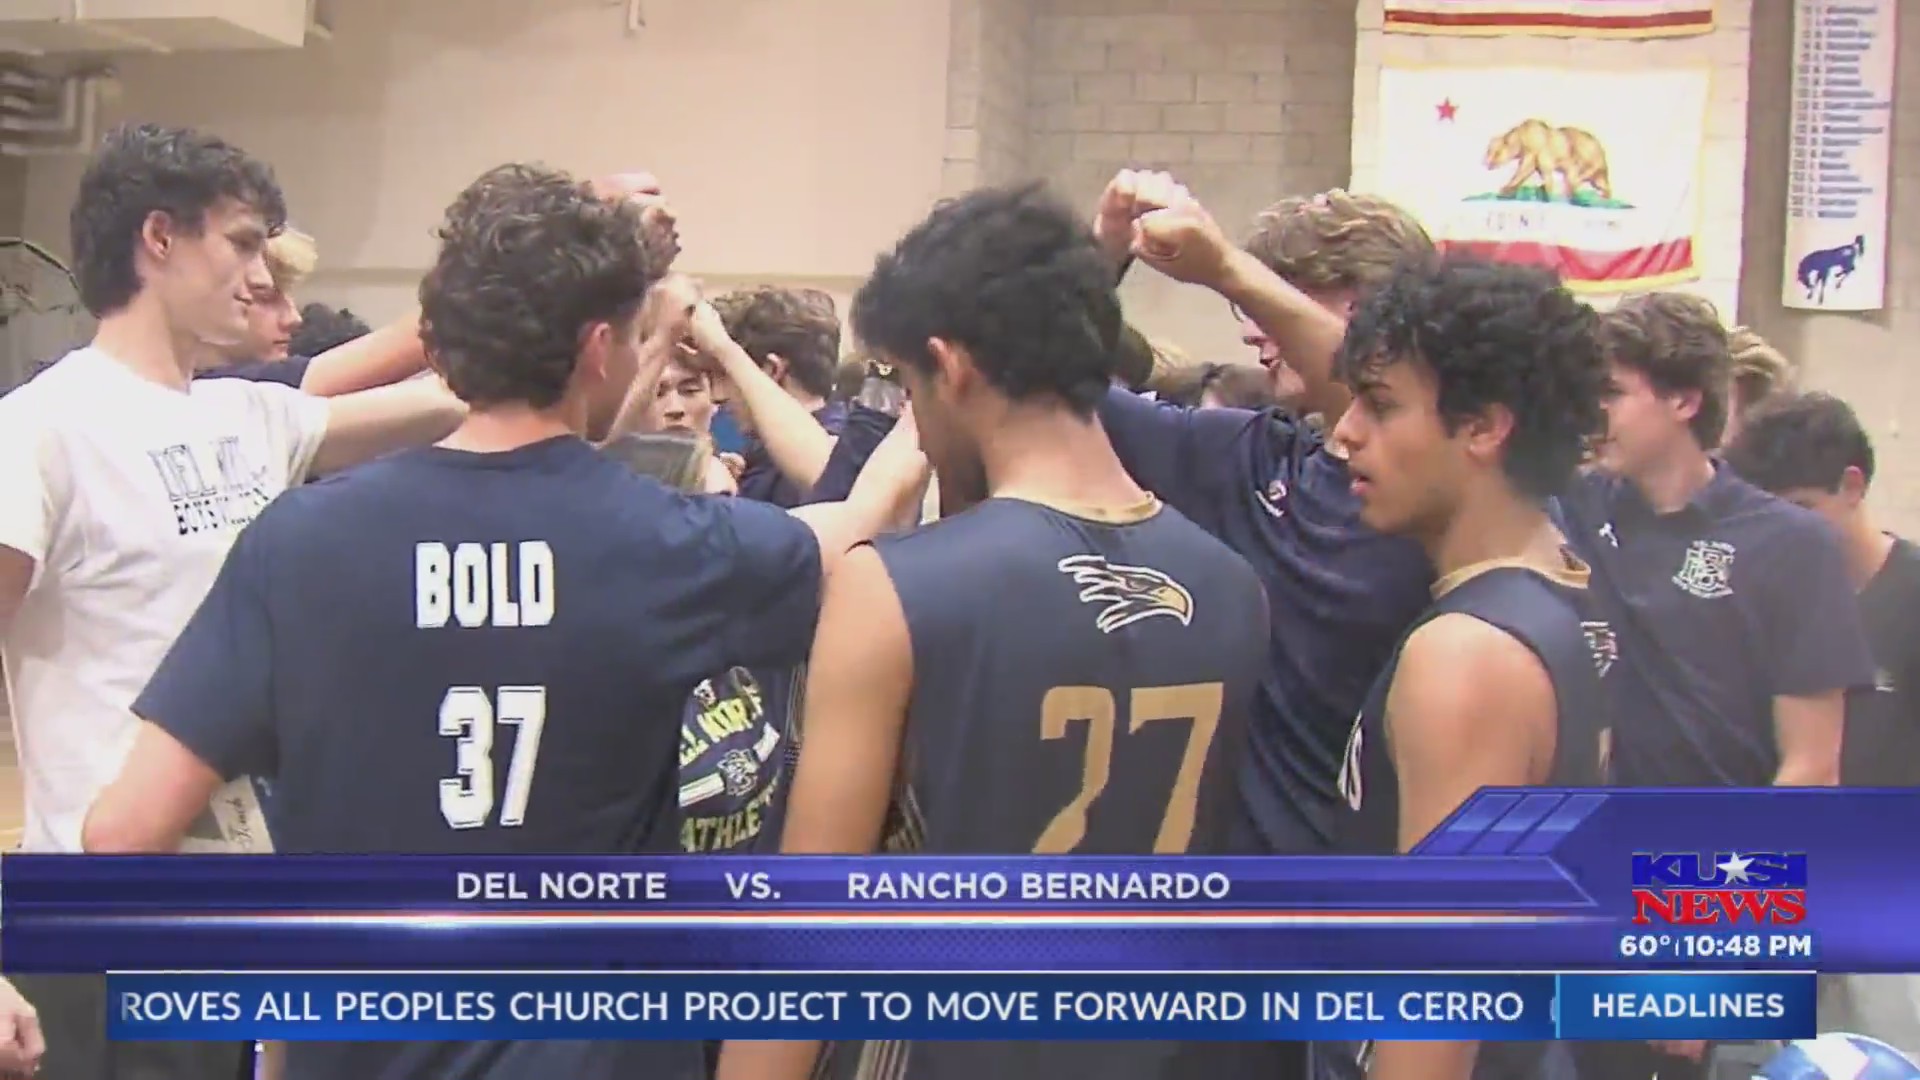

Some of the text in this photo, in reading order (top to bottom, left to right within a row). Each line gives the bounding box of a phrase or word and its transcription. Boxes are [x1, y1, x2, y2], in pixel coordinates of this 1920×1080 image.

[416, 540, 555, 628] BOLD
[439, 686, 546, 829] 37
[1031, 682, 1224, 854] 27
